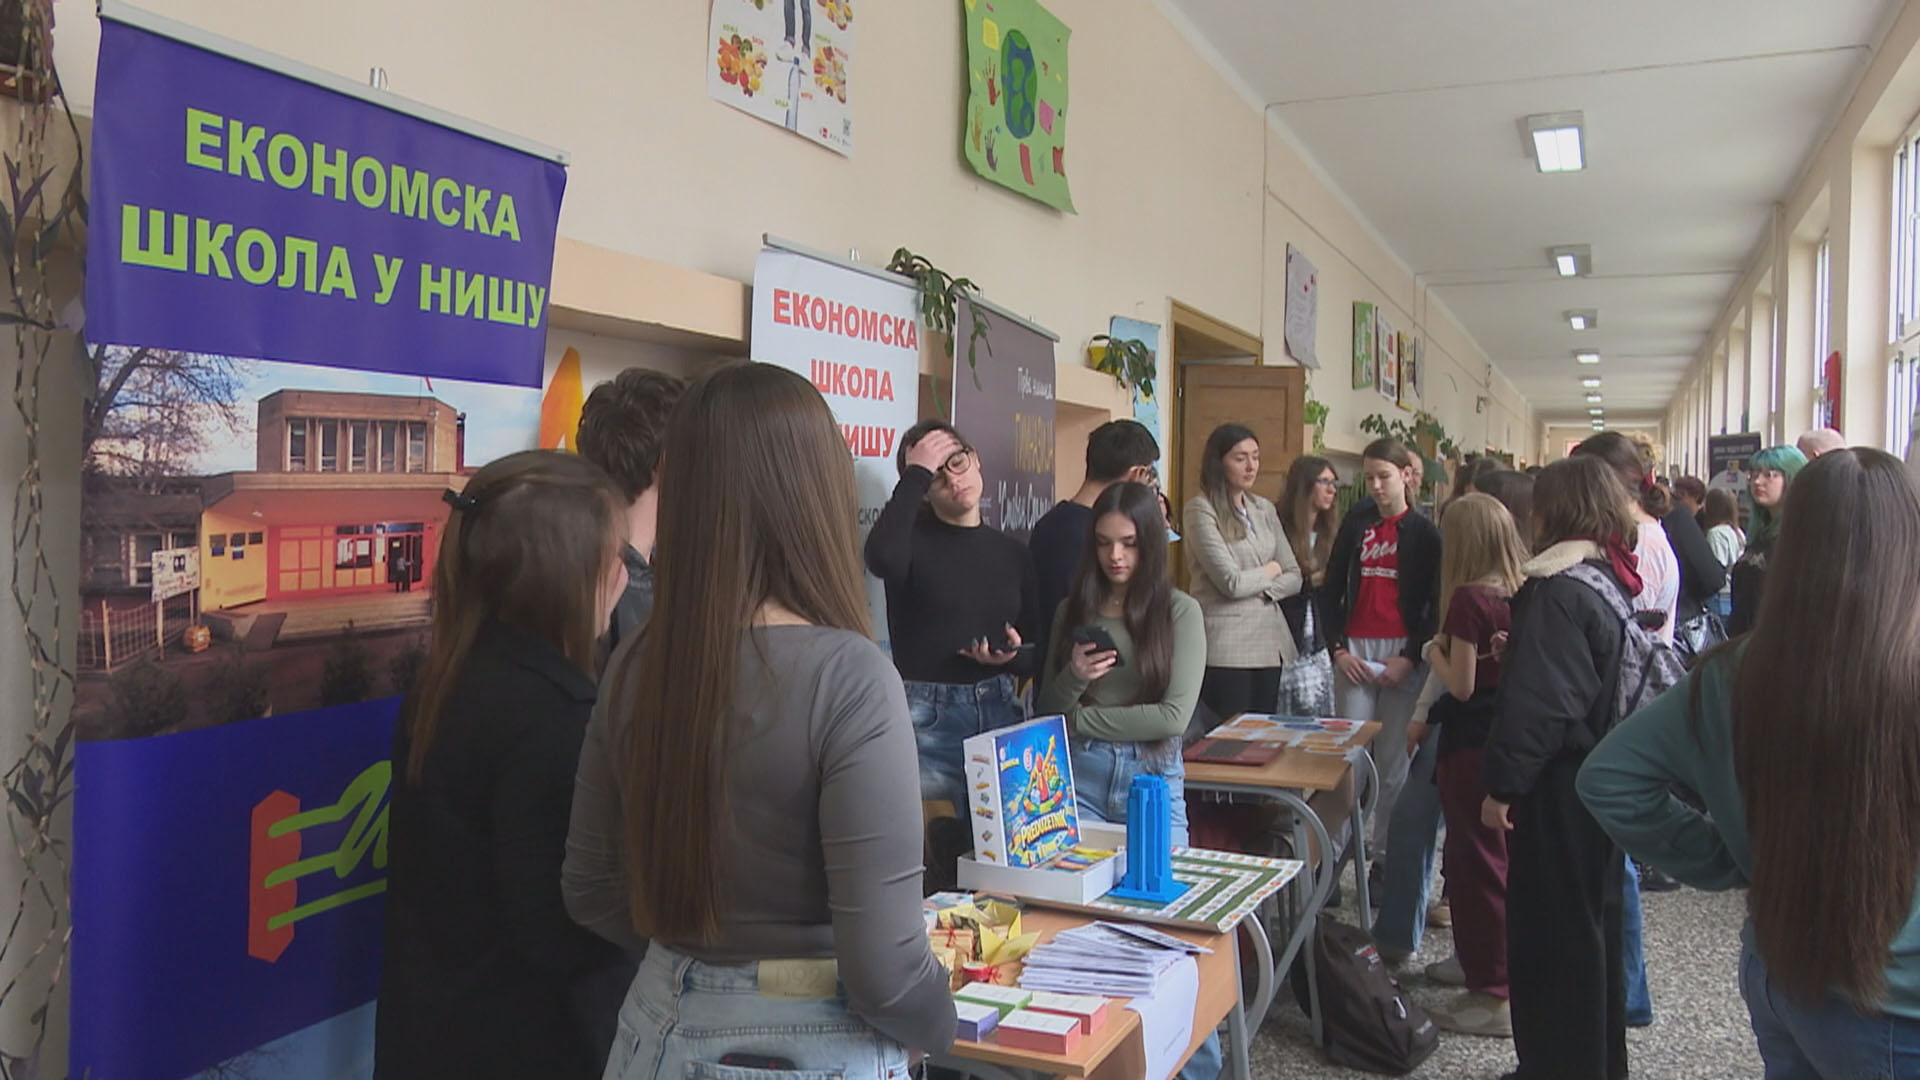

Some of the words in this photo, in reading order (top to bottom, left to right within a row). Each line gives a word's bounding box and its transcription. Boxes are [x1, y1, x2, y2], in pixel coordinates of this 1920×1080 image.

[186, 107, 520, 242] ЕКОНОМСКА
[121, 204, 357, 299] ШКОЛА
[373, 253, 403, 304] У
[419, 263, 546, 328] НИШУ
[773, 288, 918, 350] ЕКОНОМСКА
[810, 358, 895, 402] ШКОЛА
